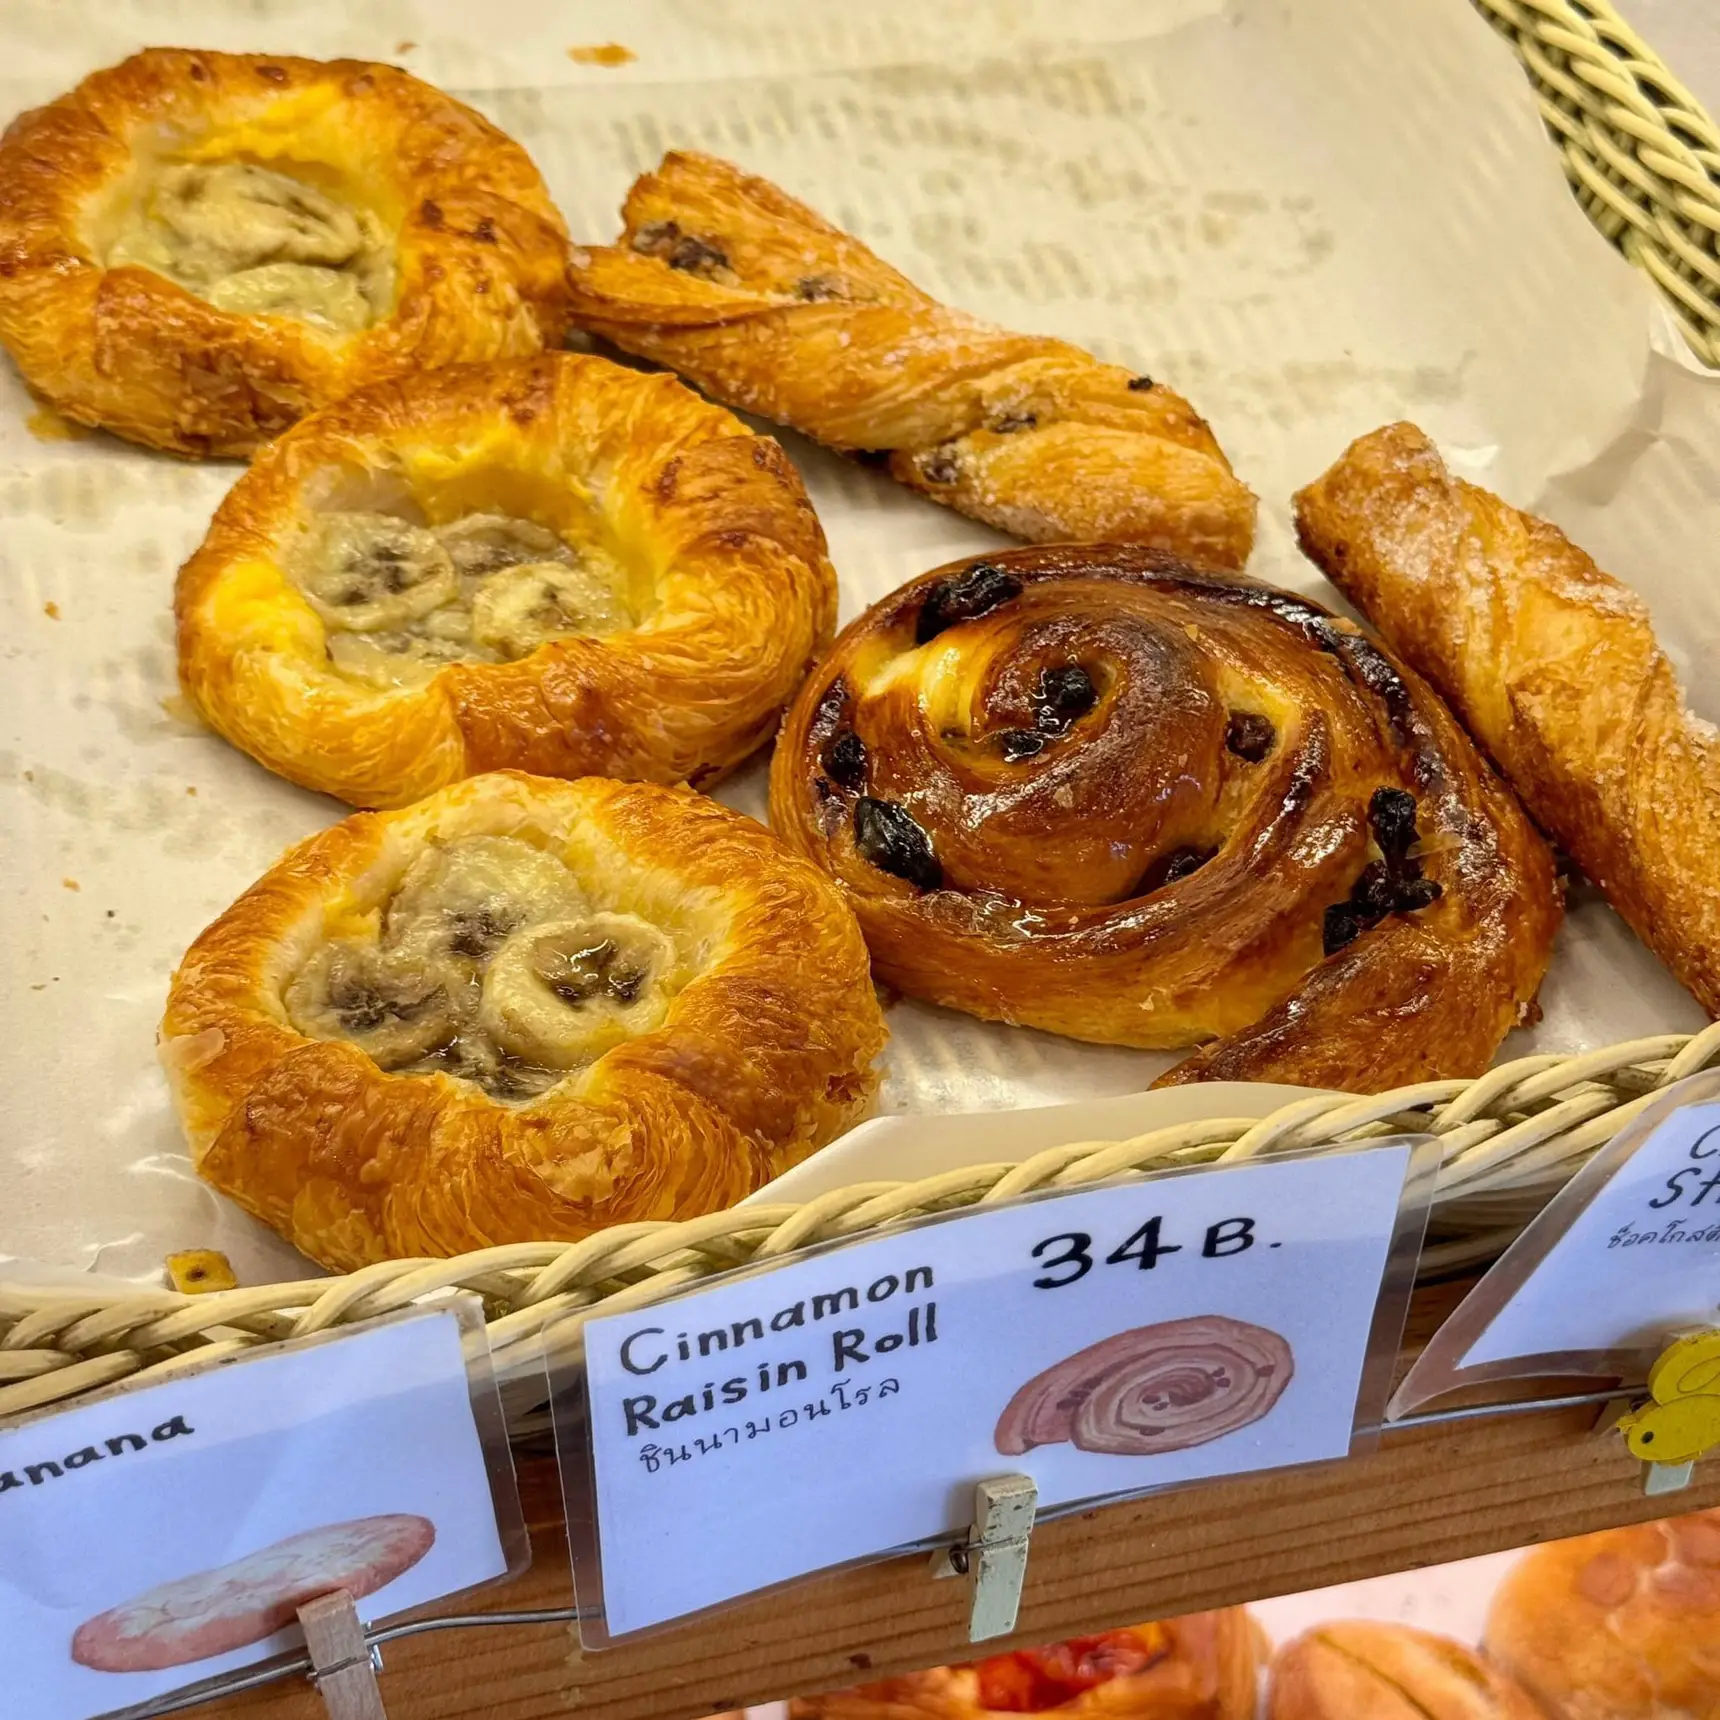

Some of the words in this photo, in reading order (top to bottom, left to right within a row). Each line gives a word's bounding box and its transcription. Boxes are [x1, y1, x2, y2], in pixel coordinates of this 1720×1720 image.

[1031, 1215, 1183, 1289] 34
[620, 1265, 934, 1375] Cinnamon
[622, 1359, 808, 1436] Raisin
[833, 1302, 938, 1373] Roll
[639, 1378, 900, 1473] ชินนามอนโรล
